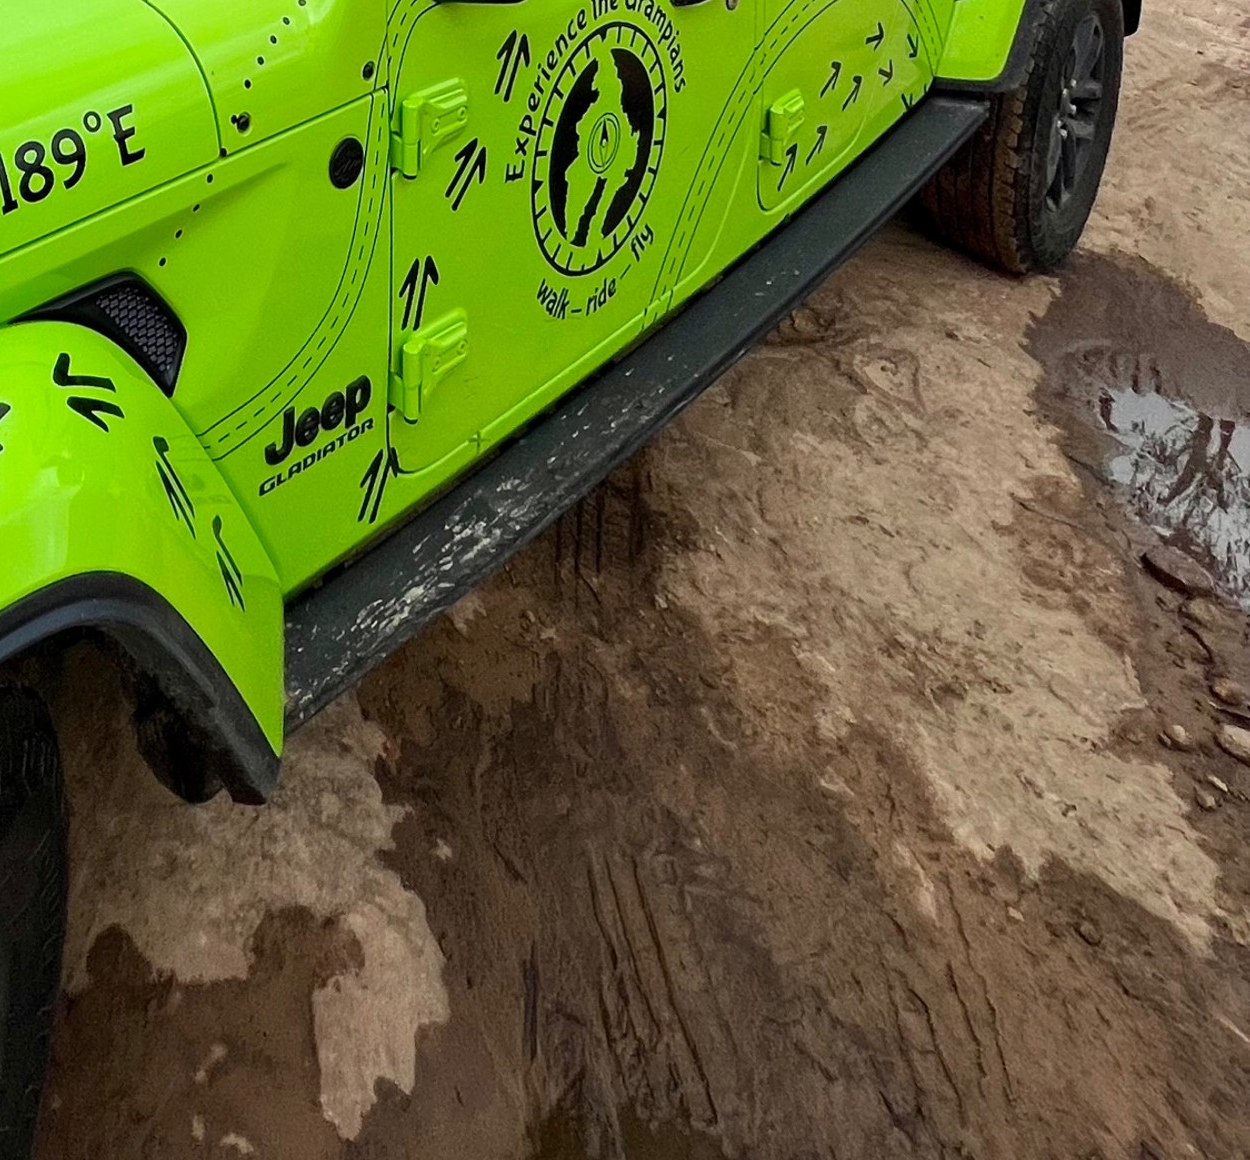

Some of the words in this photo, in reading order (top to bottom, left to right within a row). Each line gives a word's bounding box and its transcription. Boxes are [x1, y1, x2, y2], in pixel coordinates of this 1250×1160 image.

[505, 8, 588, 183] Experience
[630, 223, 654, 262] fly
[259, 417, 374, 497] GLADIATOR
[264, 375, 371, 465] Jeep
